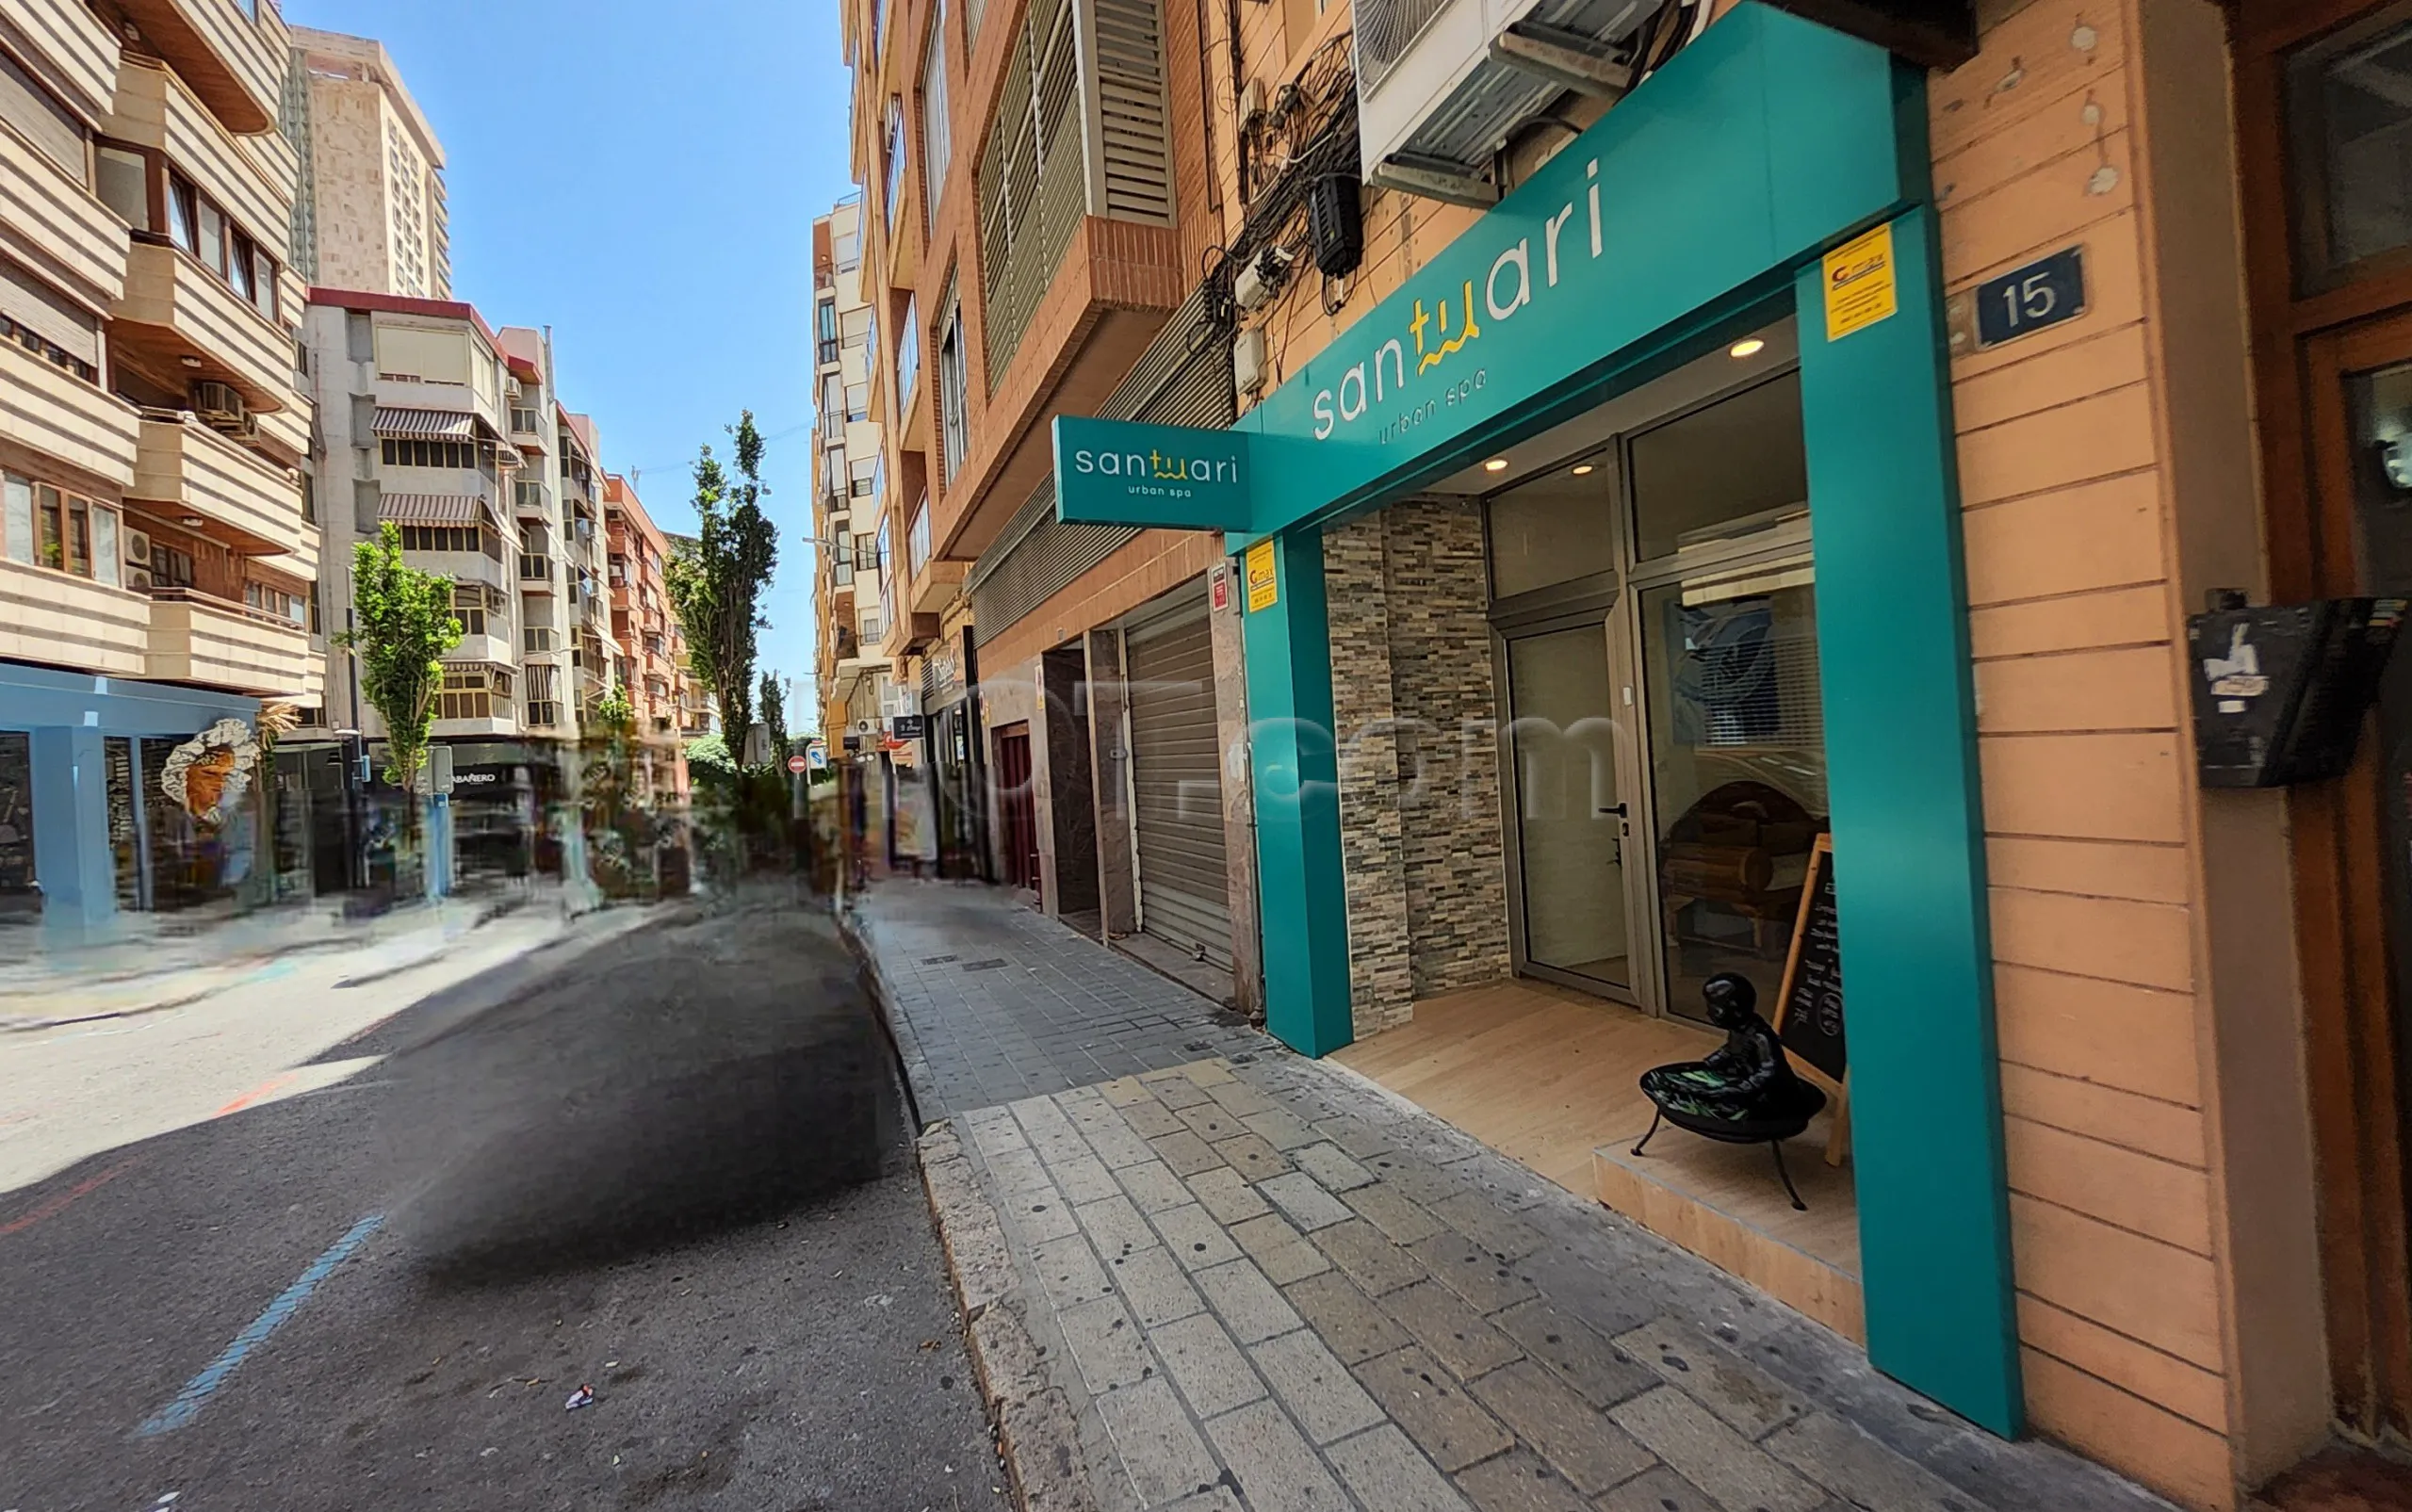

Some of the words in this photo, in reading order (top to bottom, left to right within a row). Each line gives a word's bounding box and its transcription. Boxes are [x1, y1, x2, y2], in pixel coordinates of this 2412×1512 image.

[1312, 157, 1603, 441] santuari
[2002, 270, 2055, 328] 15
[1377, 399, 1437, 446] urban
[1444, 366, 1488, 407] spa
[1075, 448, 1238, 484] santuari
[1128, 484, 1165, 496] urban
[1169, 487, 1192, 498] spa
